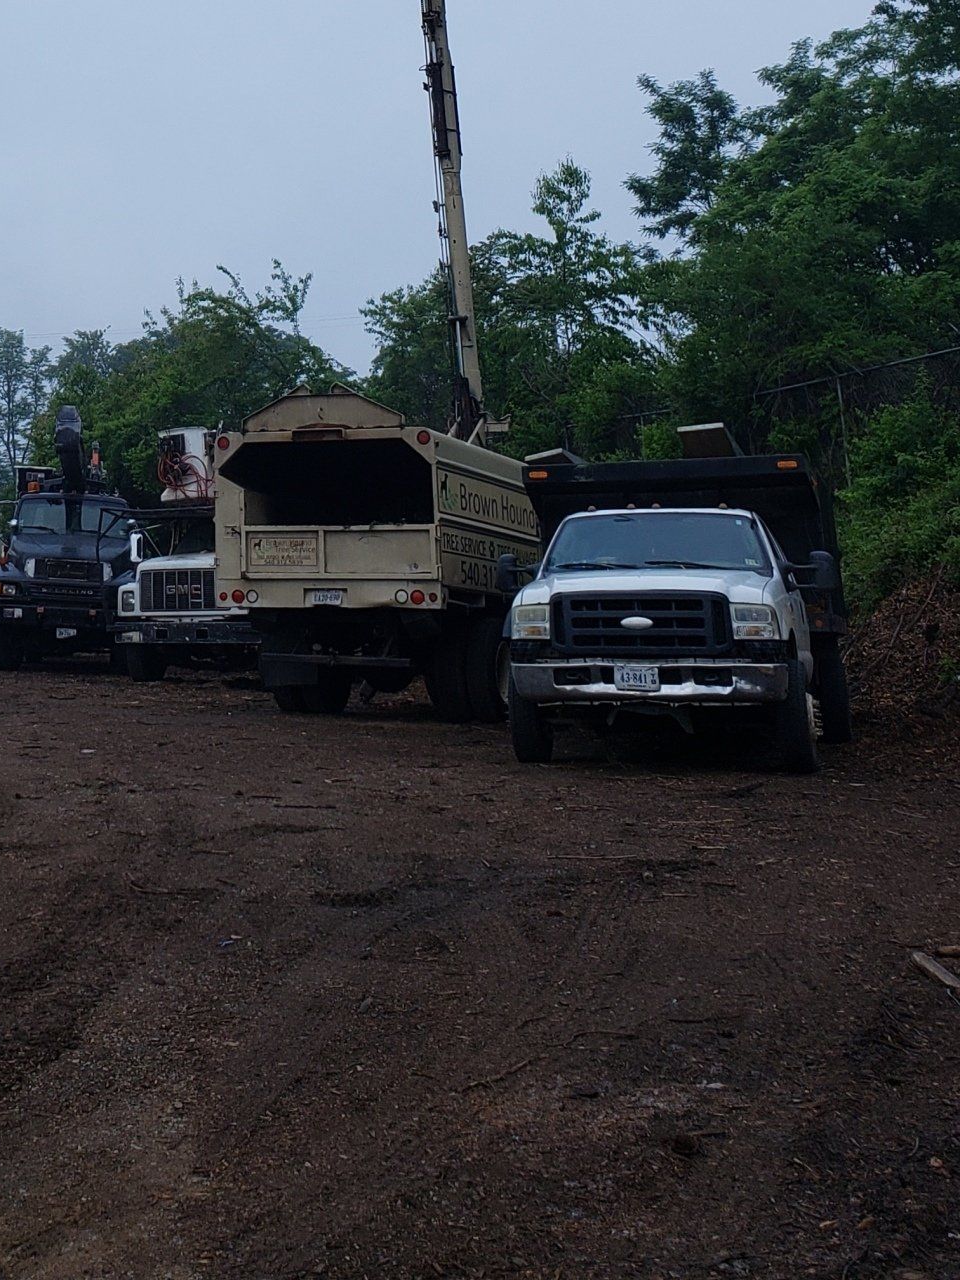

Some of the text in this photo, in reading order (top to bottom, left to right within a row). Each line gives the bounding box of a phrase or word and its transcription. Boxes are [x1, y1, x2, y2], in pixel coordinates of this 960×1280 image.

[460, 484, 498, 519] Brown
[443, 533, 459, 552] TREE
[460, 536, 487, 558] SERVICE
[166, 584, 201, 595] GMC
[620, 672, 648, 684] 43-841
